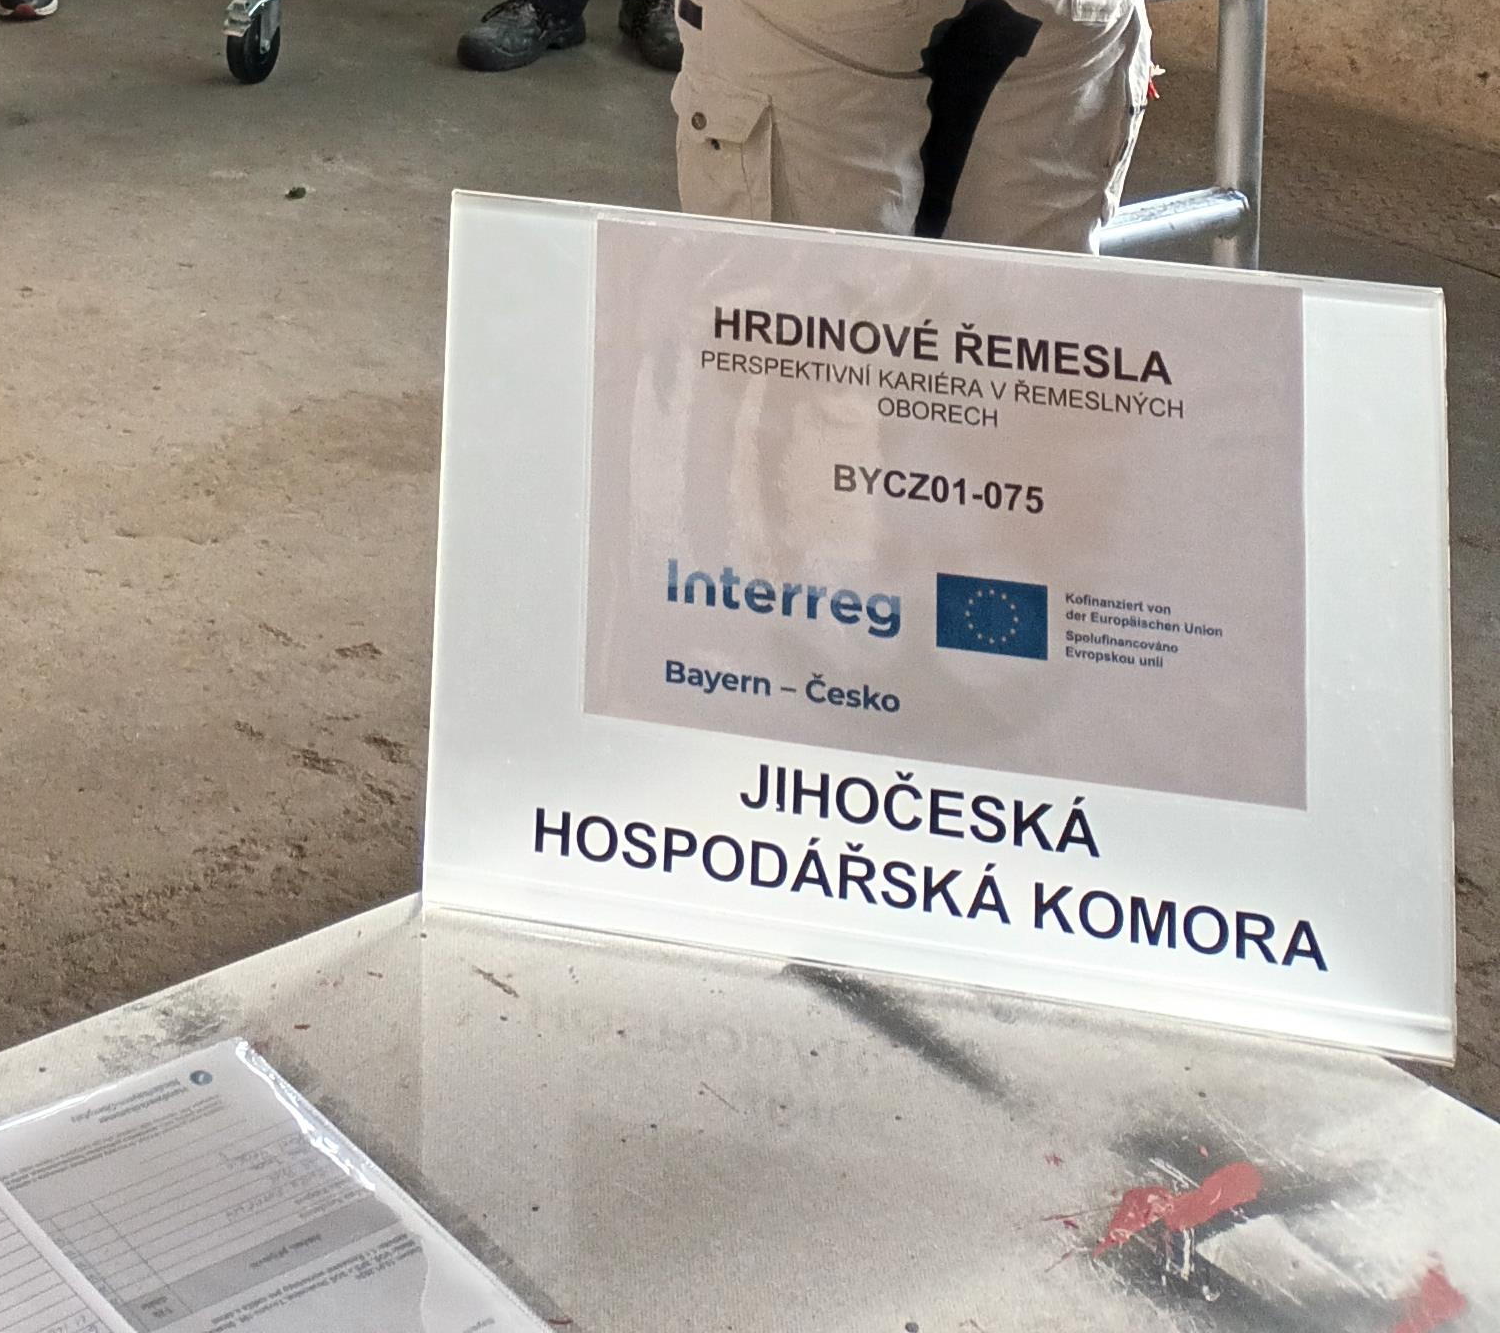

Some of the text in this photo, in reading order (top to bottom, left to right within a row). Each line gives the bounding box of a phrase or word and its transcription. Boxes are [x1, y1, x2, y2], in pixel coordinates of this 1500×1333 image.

[713, 306, 1173, 386] HRDINOVÉ ŘEMESLA
[700, 349, 1186, 421] PERSPEKTIVNÍ KARIÉRA V ŘEMESLNÝCH
[877, 397, 999, 428] OBORECH
[834, 464, 1045, 514] BYCZ01-075
[667, 558, 901, 639] Interreg
[1065, 592, 1171, 615] Kofinanziert von
[1065, 610, 1224, 638] der Europäischen Union
[1065, 629, 1178, 653] Spolufinancováno
[1065, 645, 1164, 668] Evropskou unii
[665, 659, 771, 696] Bayern
[805, 672, 901, 714] Česko
[739, 763, 1101, 859] JIHOČESKÁ
[532, 808, 1331, 974] HOSPODÁŘSKÁ KOMORA
